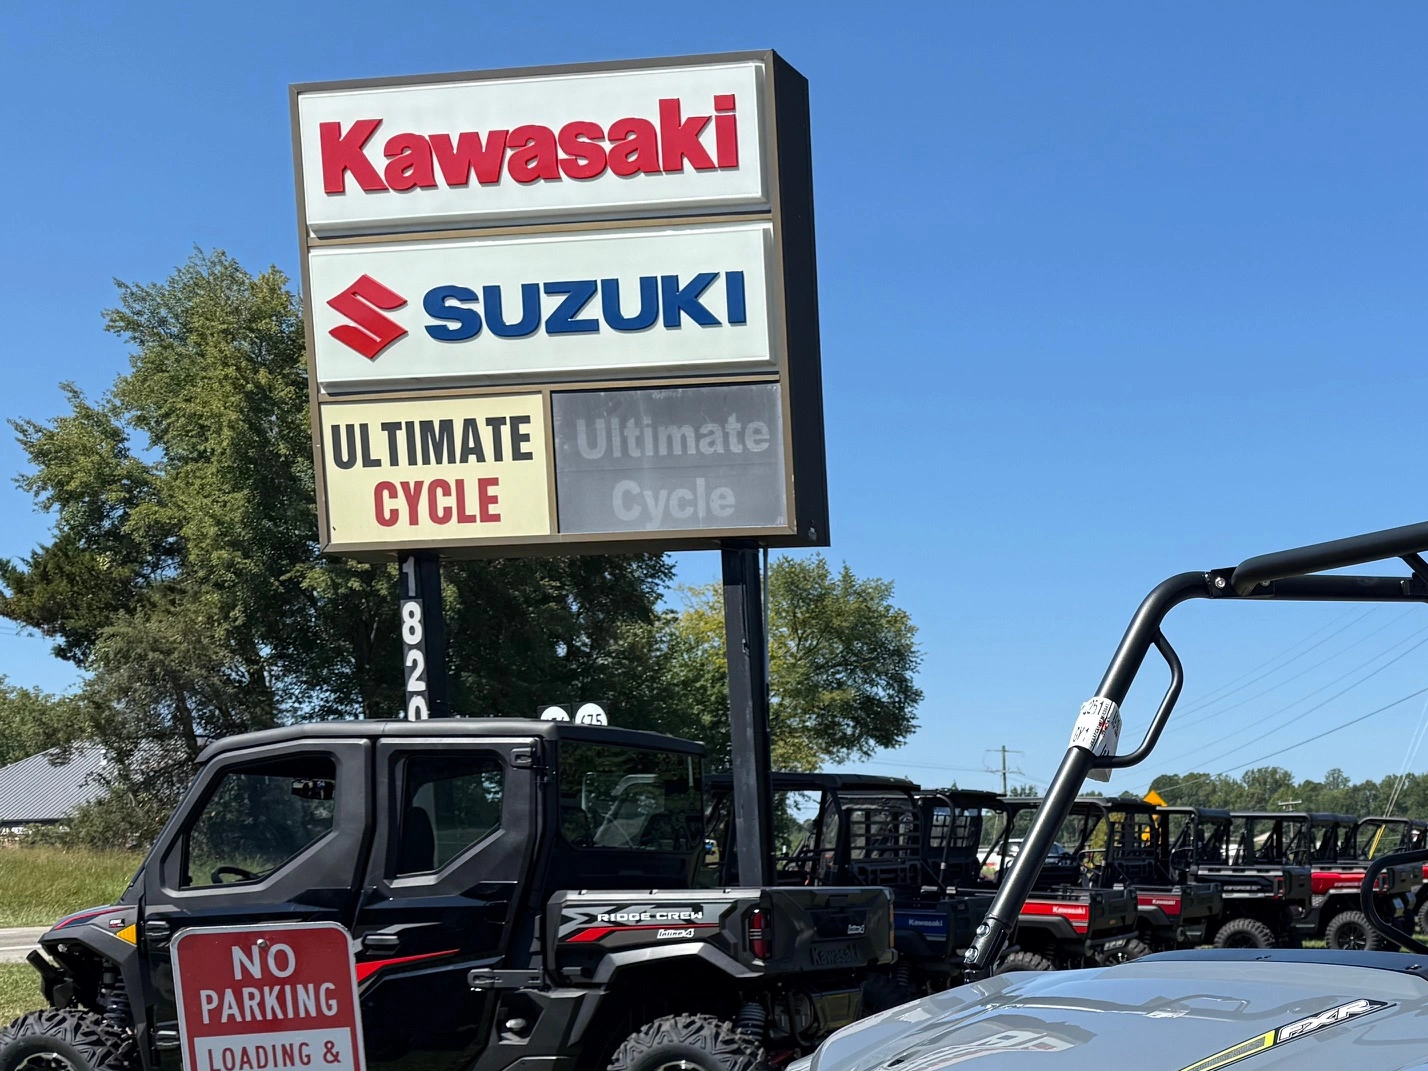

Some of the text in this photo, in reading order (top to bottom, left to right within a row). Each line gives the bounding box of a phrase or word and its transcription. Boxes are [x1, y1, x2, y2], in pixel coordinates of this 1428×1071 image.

[319, 94, 739, 194] Kawasaki
[422, 270, 747, 341] SUZUKI
[331, 415, 533, 470] ULTIMATE
[576, 414, 770, 460] Ultimate
[373, 477, 501, 527] CYCLE
[612, 477, 736, 529] Cycle
[598, 911, 703, 922] RIDGE CREW
[909, 919, 943, 927] Kawasaki
[1053, 906, 1085, 915] Kawasaki
[658, 929, 683, 938] Inline
[231, 944, 296, 980] NO
[812, 944, 860, 966] Kawasaki
[200, 982, 338, 1024] PARKING
[1278, 1000, 1381, 1042] FXR
[323, 1040, 341, 1064] &
